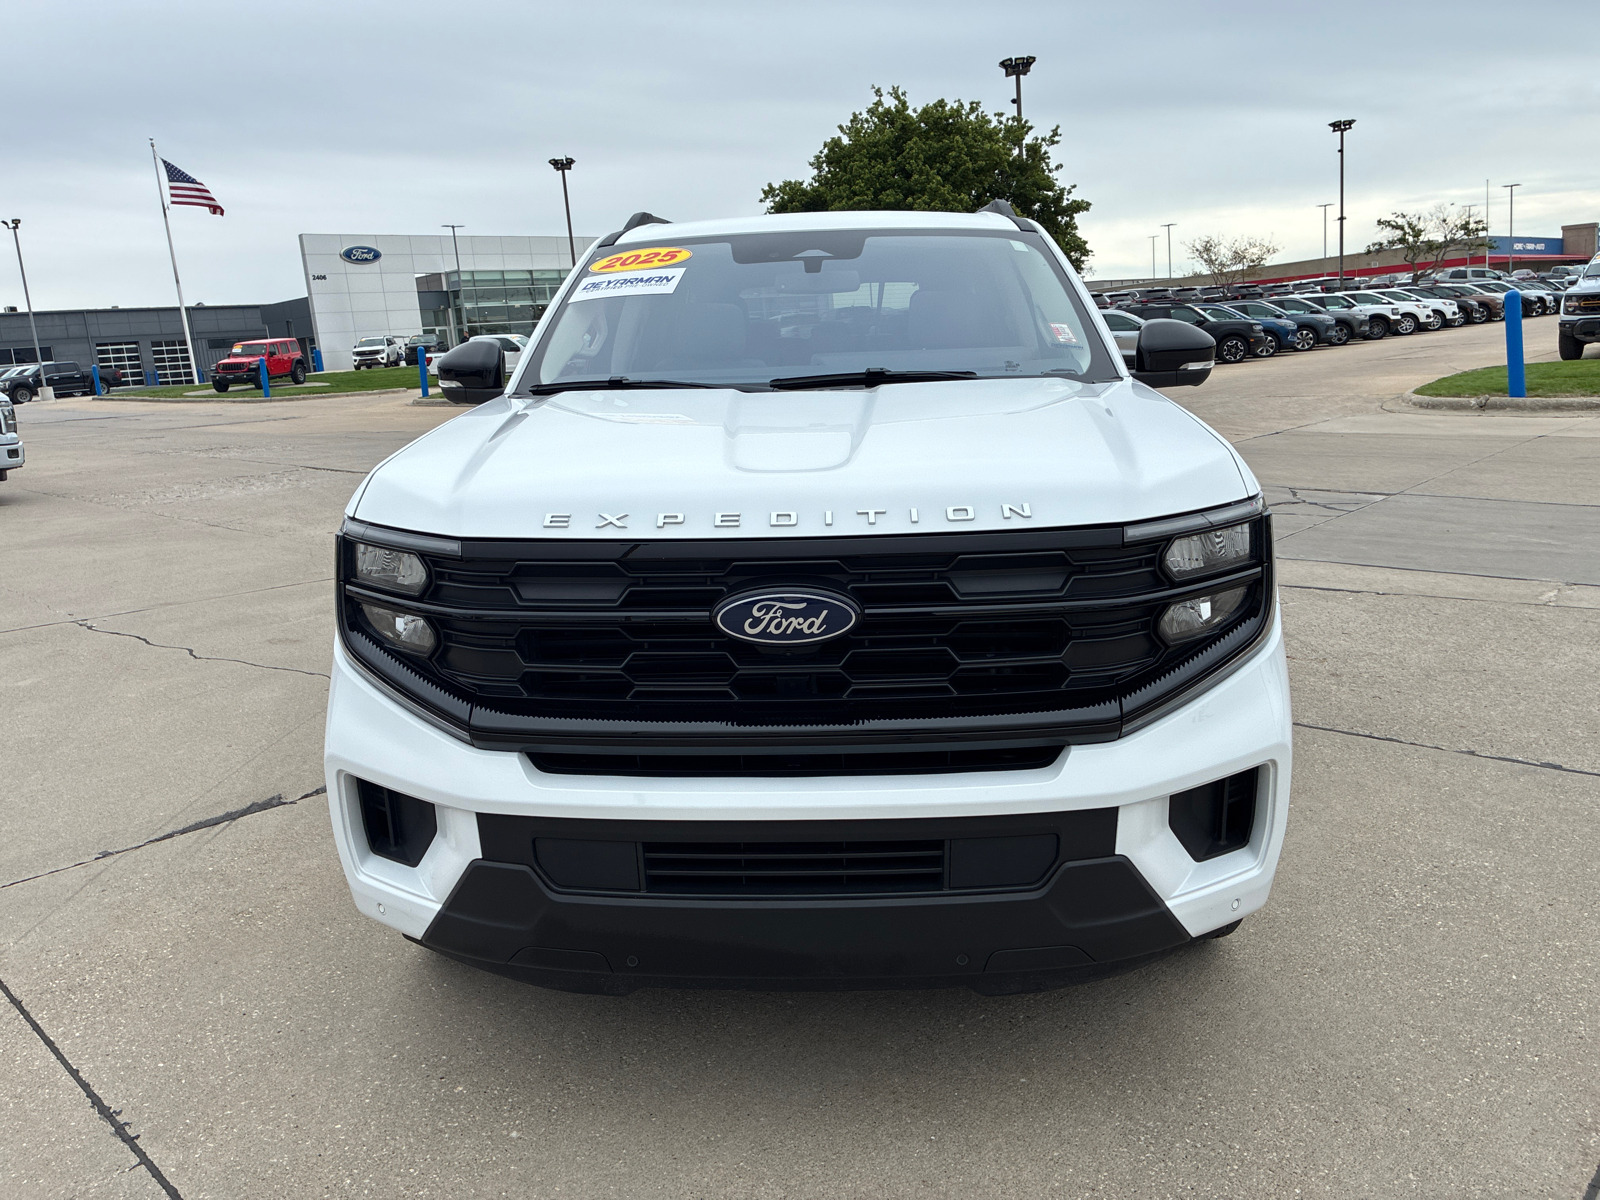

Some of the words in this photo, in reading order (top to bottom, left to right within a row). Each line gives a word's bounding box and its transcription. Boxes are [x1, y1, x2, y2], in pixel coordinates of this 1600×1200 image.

[350, 248, 374, 260] Ford
[597, 250, 682, 270] 2025
[581, 276, 676, 291] DEYARMAN
[586, 284, 623, 294] CERTIFIED
[542, 503, 1033, 529] EXPEDITION
[744, 600, 827, 636] Ford
